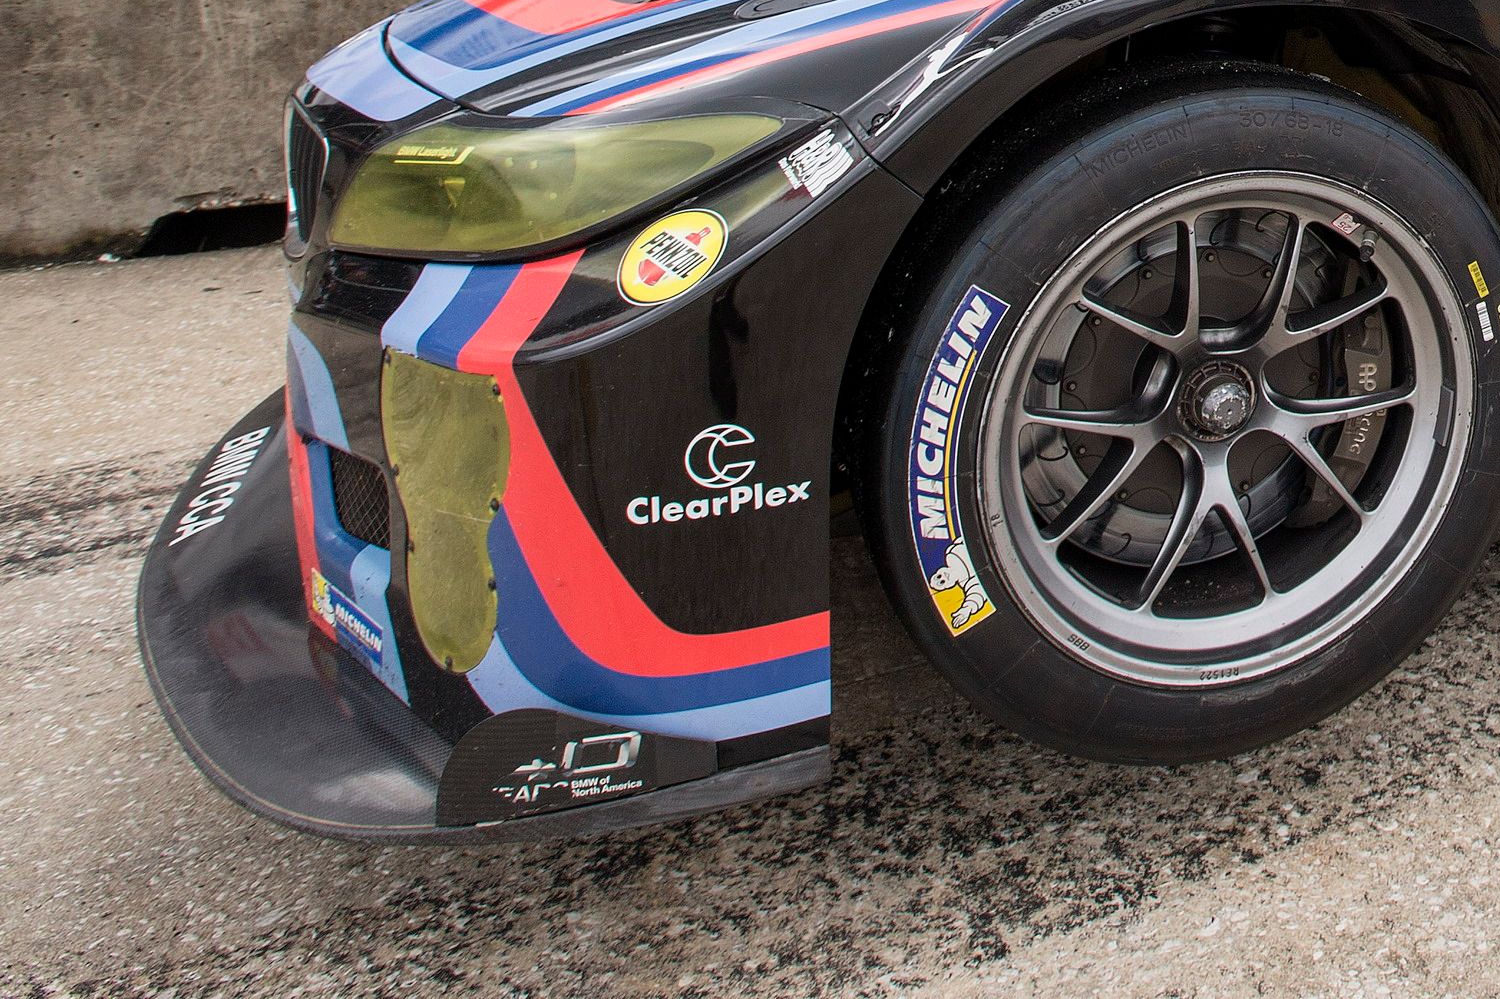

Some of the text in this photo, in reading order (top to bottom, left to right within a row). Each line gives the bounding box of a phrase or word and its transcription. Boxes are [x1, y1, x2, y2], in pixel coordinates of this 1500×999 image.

[640, 232, 707, 279] PENNZOIL
[918, 295, 992, 541] MICHELIN
[168, 426, 271, 547] BMW CCA
[626, 480, 811, 525] ClearPlex
[335, 603, 382, 652] MICHELIN
[571, 775, 611, 789] BMW of
[572, 789, 601, 798] North
[601, 780, 643, 793] America
